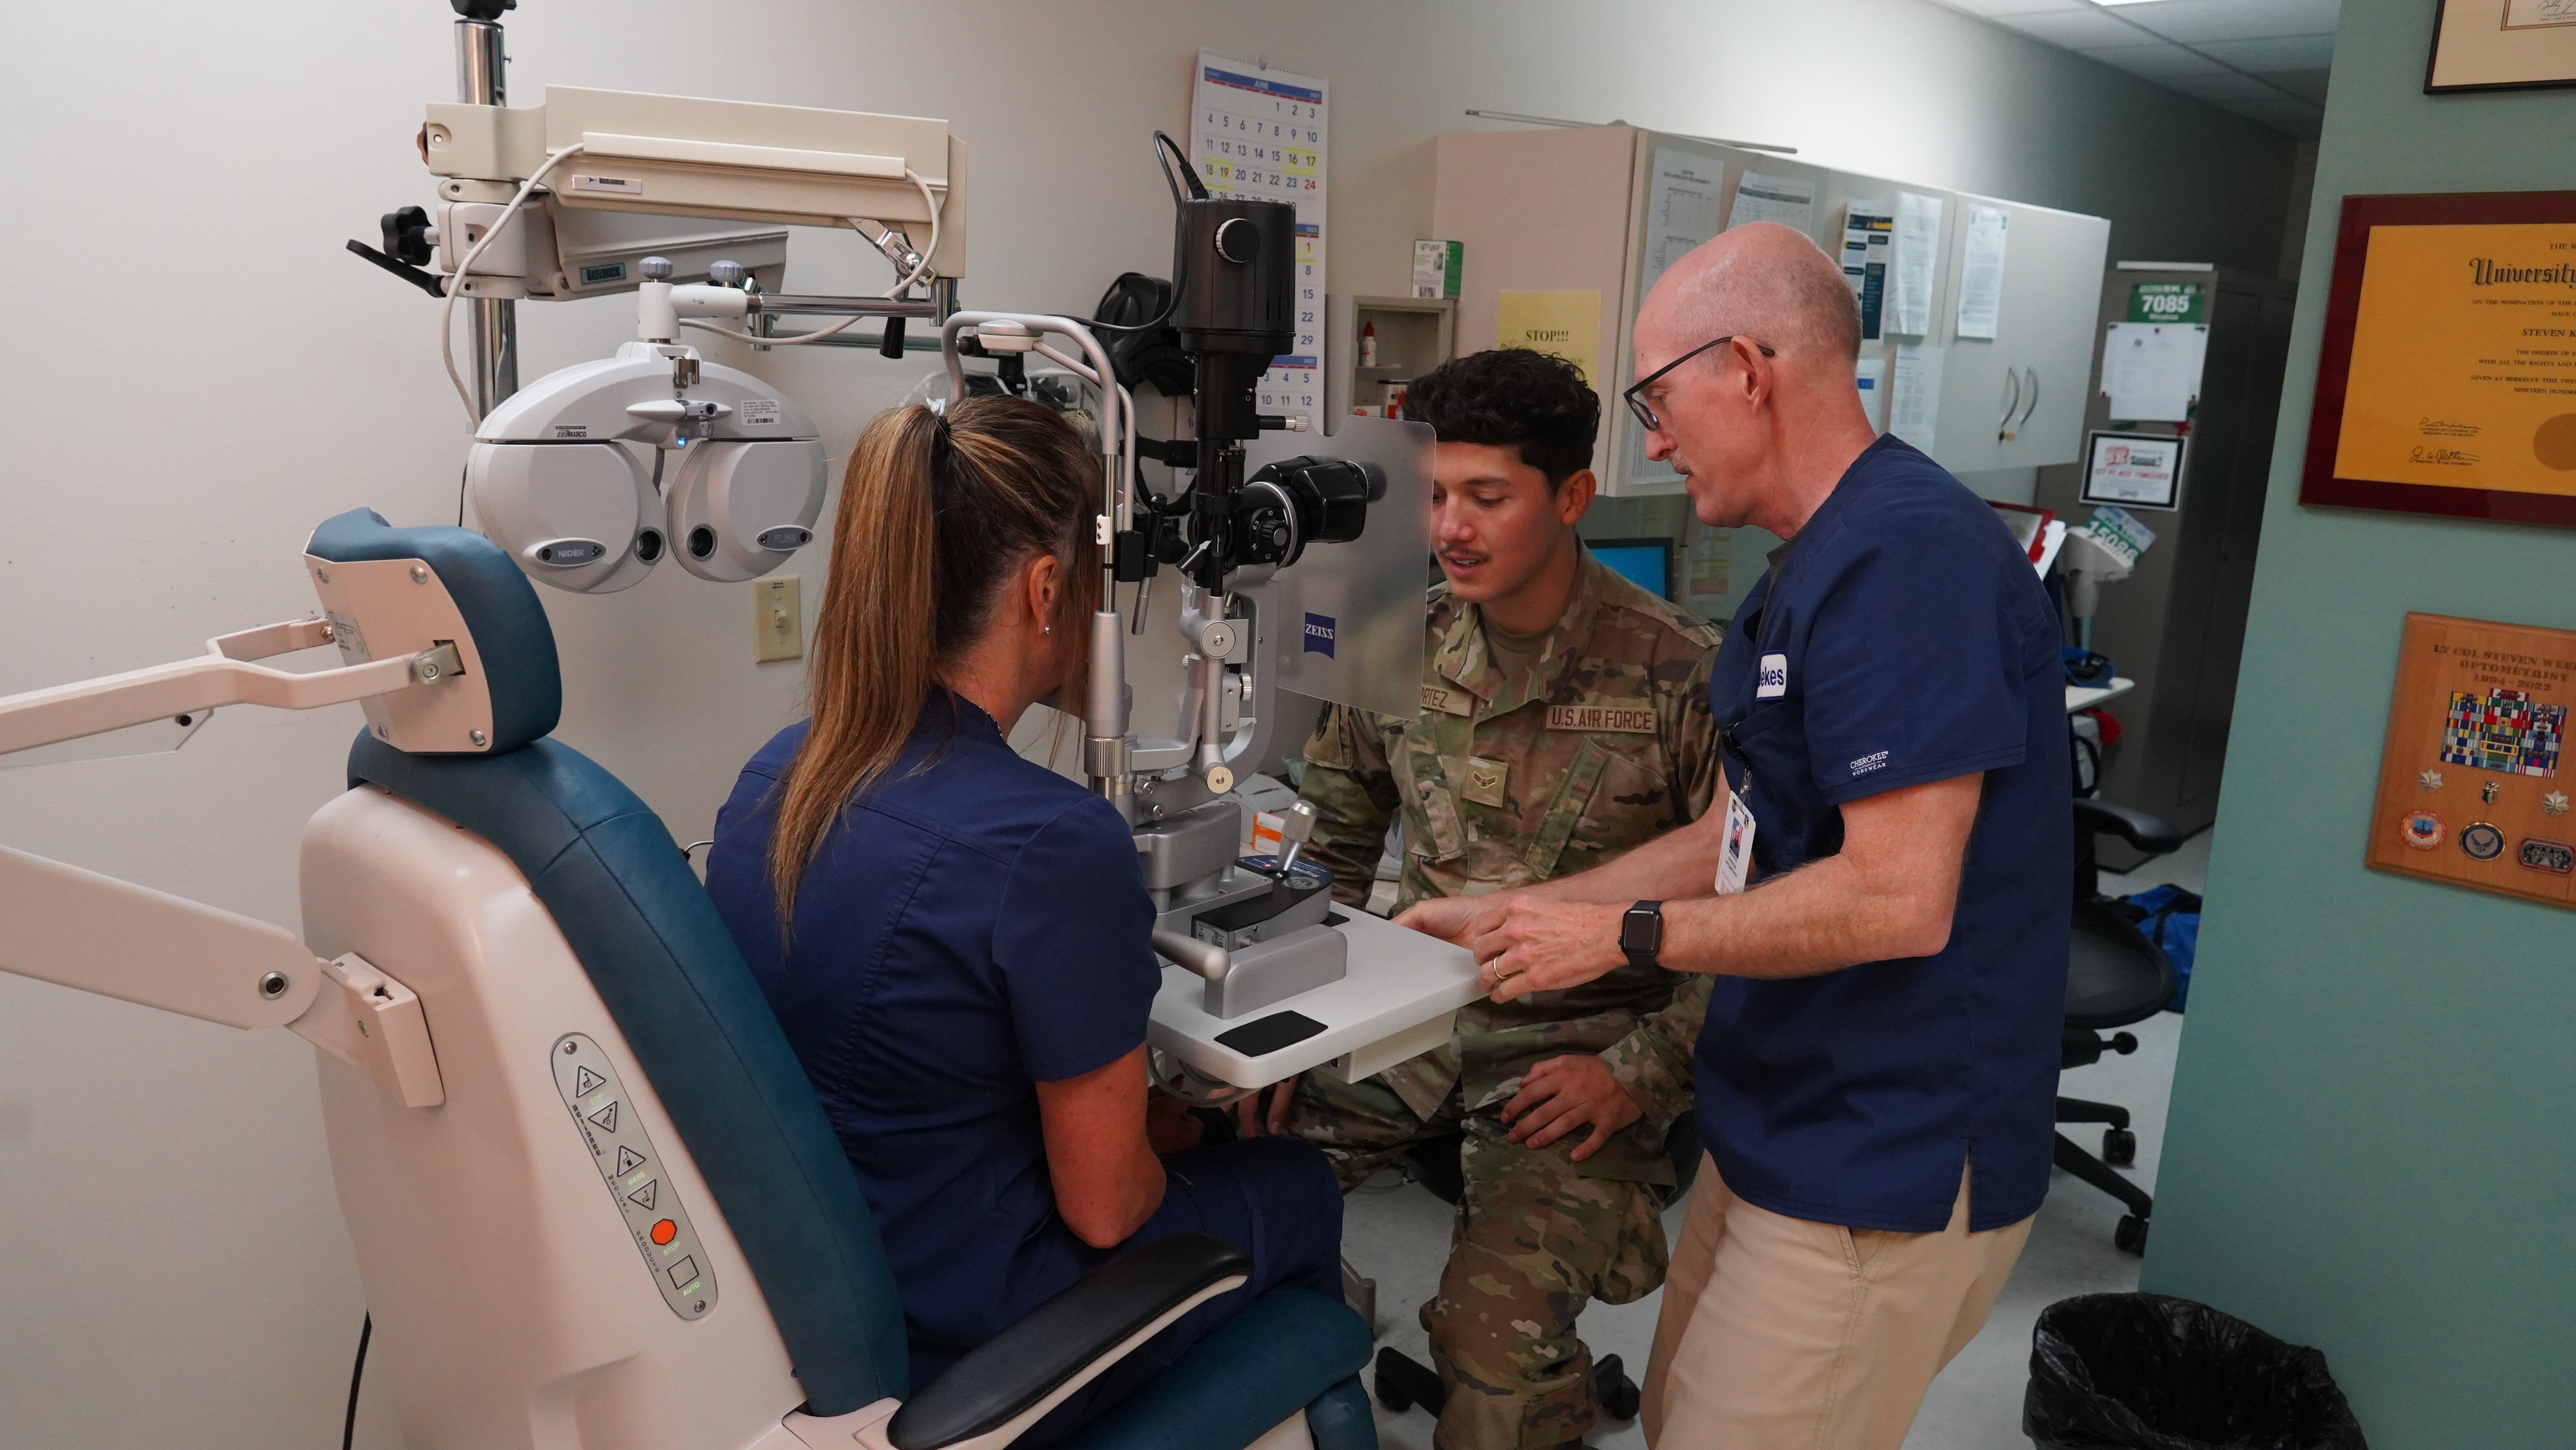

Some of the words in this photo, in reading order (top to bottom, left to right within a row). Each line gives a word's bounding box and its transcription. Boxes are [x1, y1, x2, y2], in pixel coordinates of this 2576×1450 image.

[1276, 102, 1279, 112] 1
[1293, 105, 1297, 115] 2
[1310, 108, 1315, 118] 3
[1208, 114, 1213, 123] 4
[1224, 116, 1228, 127] 5
[1240, 120, 1245, 130] 6
[1257, 123, 1262, 133] 7
[1274, 126, 1279, 136] 8
[1291, 129, 1296, 139] 9
[1308, 132, 1317, 143] 10
[1207, 139, 1213, 150] 11
[1221, 142, 1230, 153] 12
[1238, 145, 1246, 156] 13
[1255, 148, 1263, 158] 14
[1272, 150, 1280, 161] 15
[1289, 154, 1297, 164] 16
[1306, 156, 1315, 166] 17
[1206, 164, 1213, 175] 18
[1221, 168, 1228, 177] 19
[1236, 169, 1245, 180] 20
[1253, 172, 1261, 183] 21
[1270, 175, 1279, 185] 22
[1287, 177, 1297, 187] 23
[1304, 179, 1315, 190] 24
[1307, 243, 1310, 251] 1
[1306, 266, 1311, 275] 8
[1303, 290, 1313, 298] 15
[2141, 294, 2190, 313] 7085
[1302, 313, 1314, 322] 22
[1526, 330, 1569, 342] STOP!!!
[2522, 328, 2566, 337] STEVEN
[1301, 336, 1313, 345] 29
[1264, 373, 1269, 381] 3
[1283, 373, 1289, 382] 4
[1304, 374, 1309, 383] 5
[1261, 395, 1272, 404] 10
[1281, 396, 1289, 405] 11
[1302, 397, 1312, 405] 12
[558, 549, 584, 558] NIDEK
[1305, 624, 1334, 640] ZEISS
[2433, 645, 2450, 654] LT
[2454, 646, 2480, 658] COL
[2482, 650, 2537, 665] STEVEN
[1759, 666, 1784, 687] ekes
[2460, 660, 2569, 682] OPTOMETRIST
[2518, 679, 2552, 692] 2022
[1552, 708, 1576, 726] U.S.
[1578, 709, 1601, 728] AIR
[1605, 709, 1652, 730] FORCE
[1850, 751, 1887, 769] CHEROKEE
[1852, 762, 1886, 776] WORKWEAR
[628, 1171, 647, 1186] BASE
[608, 1175, 630, 1213] MEDICAL
[637, 1230, 660, 1273] PRODUCTS
[663, 1241, 680, 1256] STOP
[683, 1281, 700, 1297] AUTO
